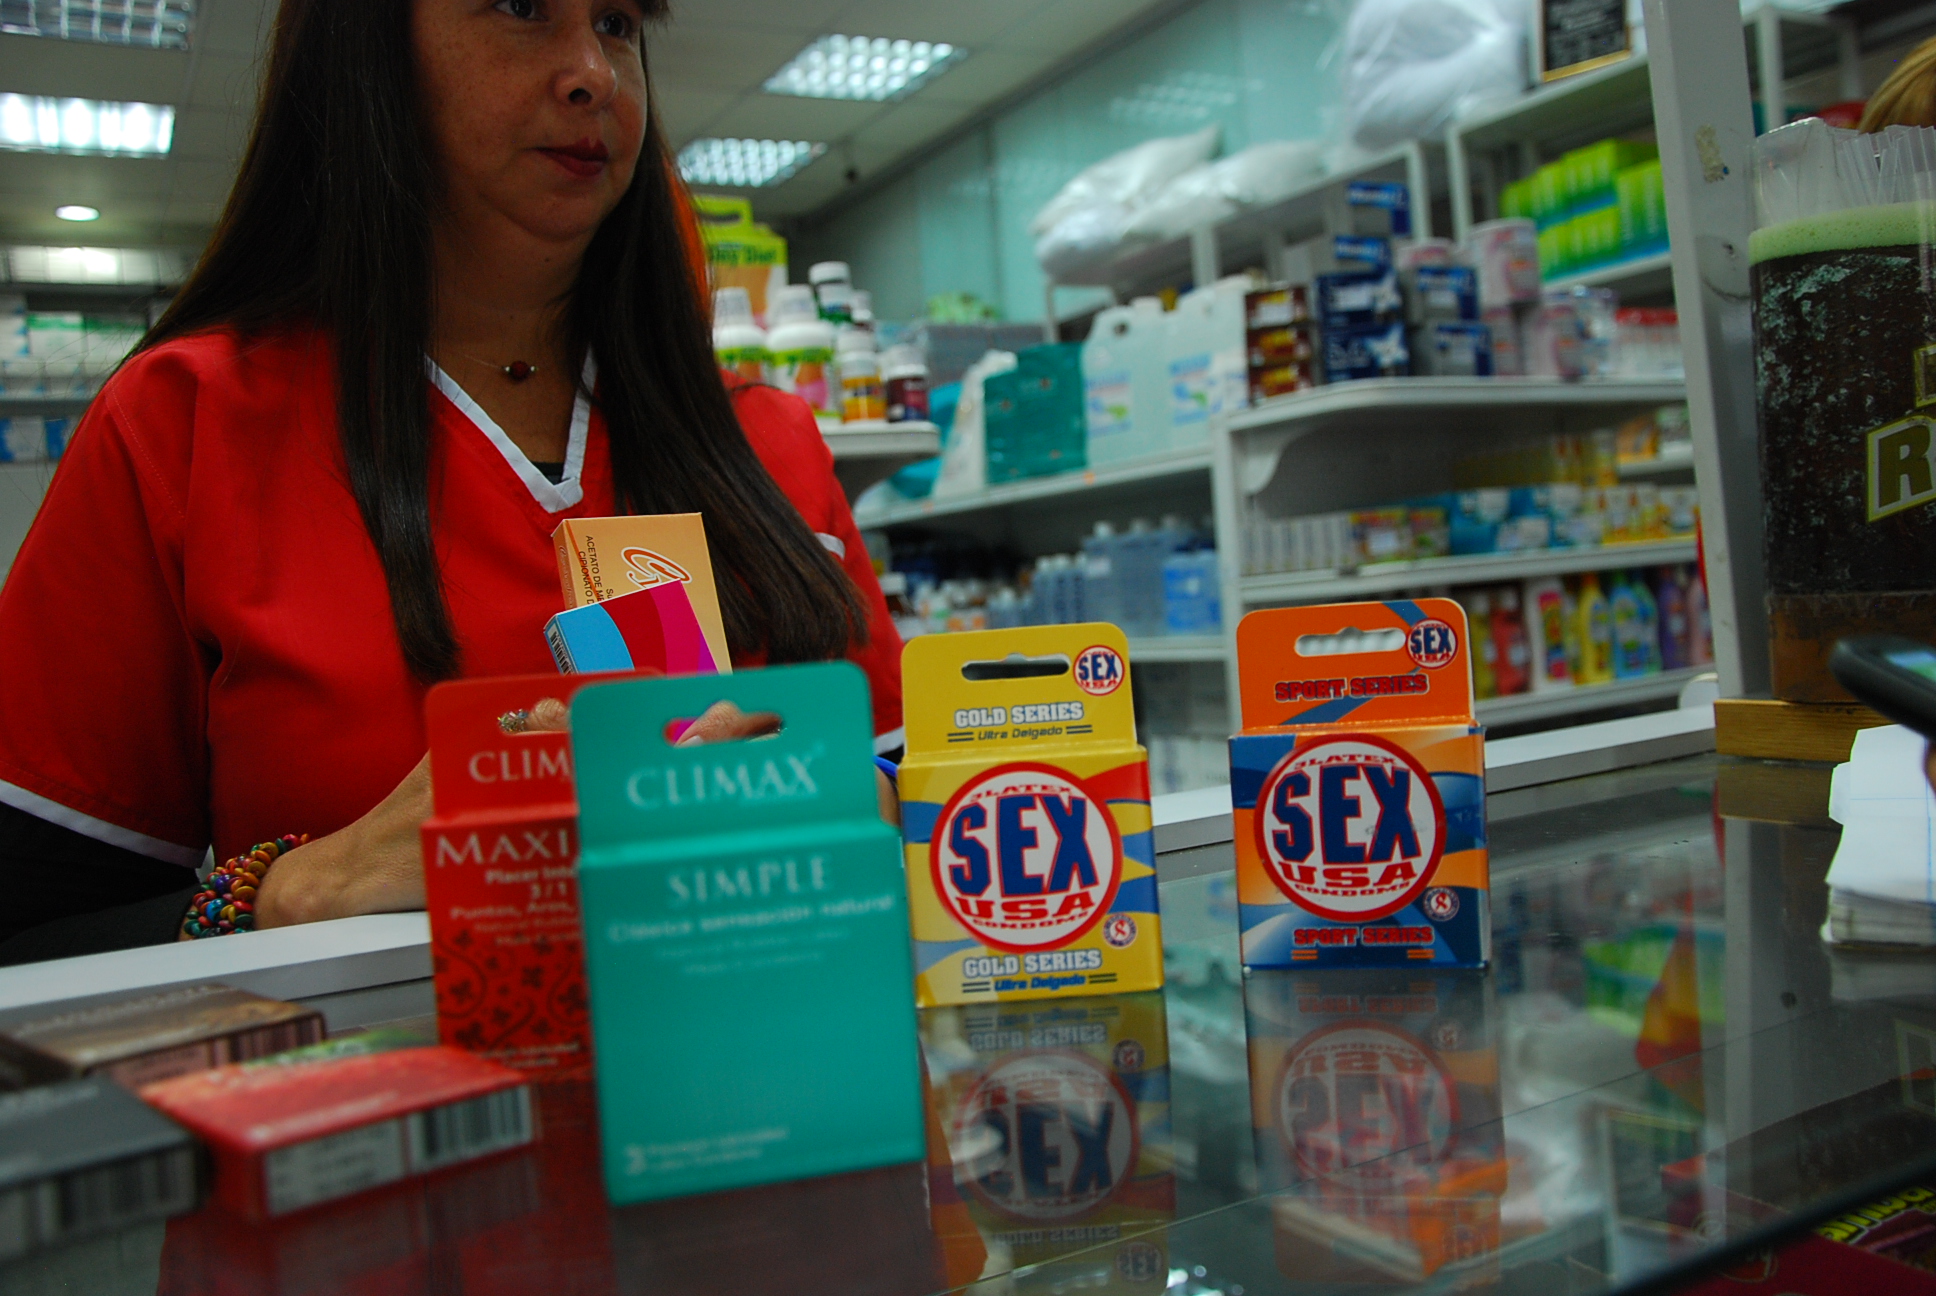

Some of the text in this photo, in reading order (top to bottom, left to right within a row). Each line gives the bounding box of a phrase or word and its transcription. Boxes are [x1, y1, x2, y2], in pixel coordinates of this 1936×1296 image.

[578, 551, 594, 596] CIPIONATO
[585, 535, 600, 574] ACETATO
[594, 574, 602, 586] DE
[1410, 626, 1452, 655] SEX
[1078, 654, 1119, 681] SEX
[1274, 673, 1429, 702] SPORT SERIES
[954, 701, 1084, 729] GOLD SERIES
[977, 726, 1063, 741] Ultra Delgado
[626, 752, 819, 810] CLIMAX
[1271, 762, 1423, 866] SEX
[948, 793, 1100, 897] SEX
[668, 854, 831, 906] SIMPLE
[1277, 860, 1418, 889] USA
[955, 890, 1096, 921] USA
[1292, 925, 1434, 946] SPORT SERIES
[963, 949, 1102, 979] GOLD SERIES
[994, 974, 1086, 991] Ultra Delgado
